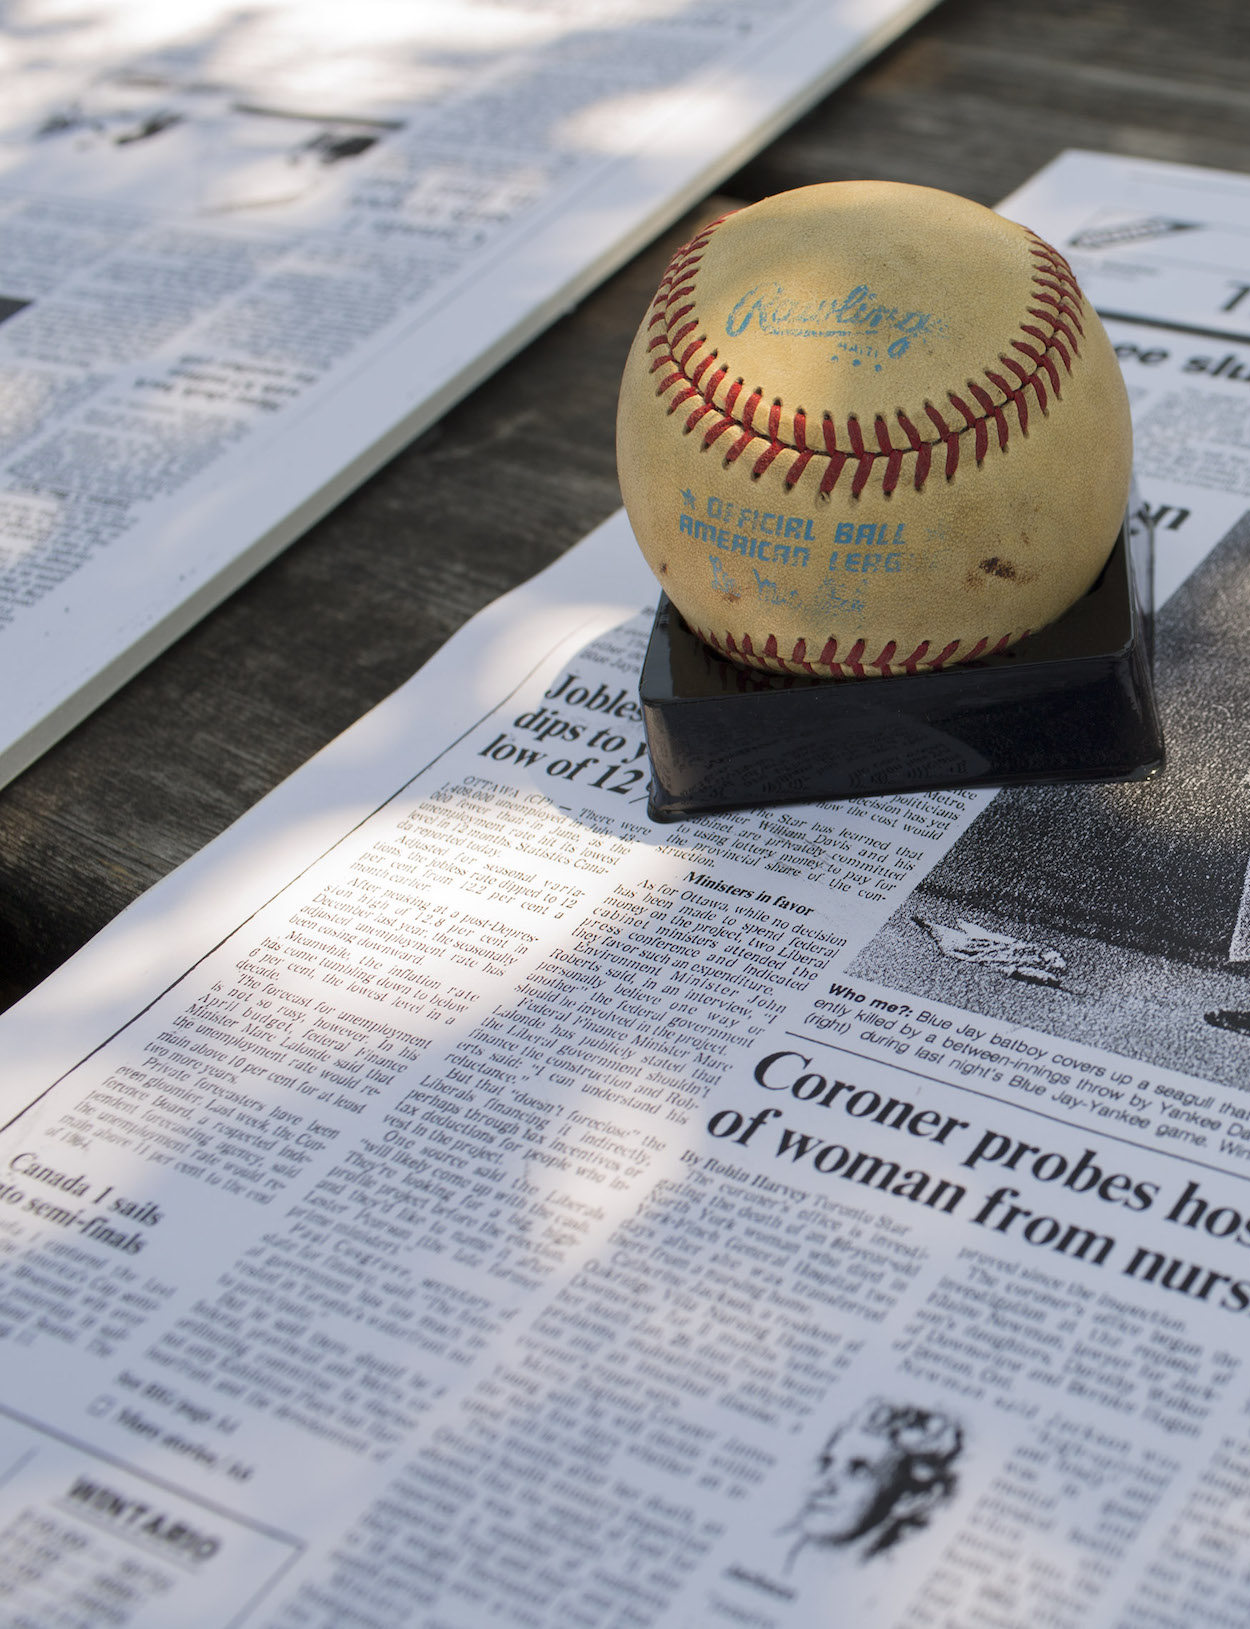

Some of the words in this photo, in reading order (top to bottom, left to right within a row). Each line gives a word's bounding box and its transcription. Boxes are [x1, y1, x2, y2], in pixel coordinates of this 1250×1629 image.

[726, 281, 949, 358] Rawling
[679, 513, 811, 568] AMERICAN
[828, 550, 925, 574] LEAG
[707, 497, 816, 542] OFFICIAL
[834, 523, 907, 546] BALL
[513, 708, 587, 743] dips
[589, 728, 627, 753] to
[544, 674, 645, 723] Jobles
[478, 734, 548, 769] low
[546, 757, 599, 782] of
[676, 824, 690, 833] to
[693, 830, 729, 846] using
[731, 838, 777, 859] lottery
[778, 853, 828, 870] money
[822, 864, 842, 875] to
[842, 870, 872, 885] pay
[874, 878, 896, 891] for
[684, 815, 734, 833] cabinet
[738, 830, 761, 841] are
[765, 836, 826, 858] privately
[828, 853, 906, 881] committed
[750, 803, 773, 819] The
[777, 814, 807, 827] Star
[810, 821, 832, 838] has
[838, 828, 891, 850] learned
[895, 846, 923, 860] that
[758, 820, 807, 843] William
[806, 834, 852, 851] Davis
[857, 848, 889, 863] and
[894, 857, 916, 871] his
[666, 834, 688, 846] the
[691, 842, 764, 866] provincial
[764, 861, 801, 876] share
[807, 872, 825, 882] of
[828, 878, 861, 892] the
[857, 889, 886, 901] con-
[683, 871, 754, 898] Ministers
[754, 890, 772, 903] in
[772, 895, 814, 916] favor
[185, 1003, 239, 1027] Minister
[241, 1023, 276, 1042] Marc
[279, 1036, 331, 1062] Lalonde
[333, 1059, 365, 1073] said
[365, 1068, 395, 1085] that
[813, 999, 852, 1018] ently
[854, 1009, 898, 1030] killed
[899, 1023, 922, 1039] by
[924, 1033, 937, 1044] a
[942, 1037, 1071, 1085] between-innings
[1076, 1078, 1125, 1101] throw
[1128, 1093, 1152, 1111] by
[1160, 1101, 1222, 1131] Yankee
[828, 983, 866, 1003] Who
[869, 998, 913, 1017] me?:
[915, 1010, 953, 1030] Blue
[956, 1024, 986, 1041] Jay
[989, 1033, 1048, 1060] batboy
[1051, 1054, 1106, 1077] covers
[1110, 1071, 1133, 1085] up
[1137, 1080, 1150, 1090] a
[1154, 1085, 1215, 1108] seagull
[803, 1012, 851, 1035] (right)
[860, 1031, 910, 1055] during
[914, 1045, 945, 1064] last
[948, 1059, 1003, 1082] night's
[1008, 1074, 1047, 1096] Blue
[1051, 1091, 1150, 1129] Jay-Yankee
[1155, 1124, 1207, 1147] game.
[754, 1051, 968, 1143] Coroner
[963, 1131, 1158, 1211] probes
[10, 1152, 90, 1197] Canada
[92, 1186, 114, 1204] 1
[109, 1198, 162, 1226] sails
[707, 1108, 782, 1146] of
[777, 1130, 965, 1213] woman
[972, 1187, 1115, 1265] from
[24, 1198, 145, 1254] semi-finals
